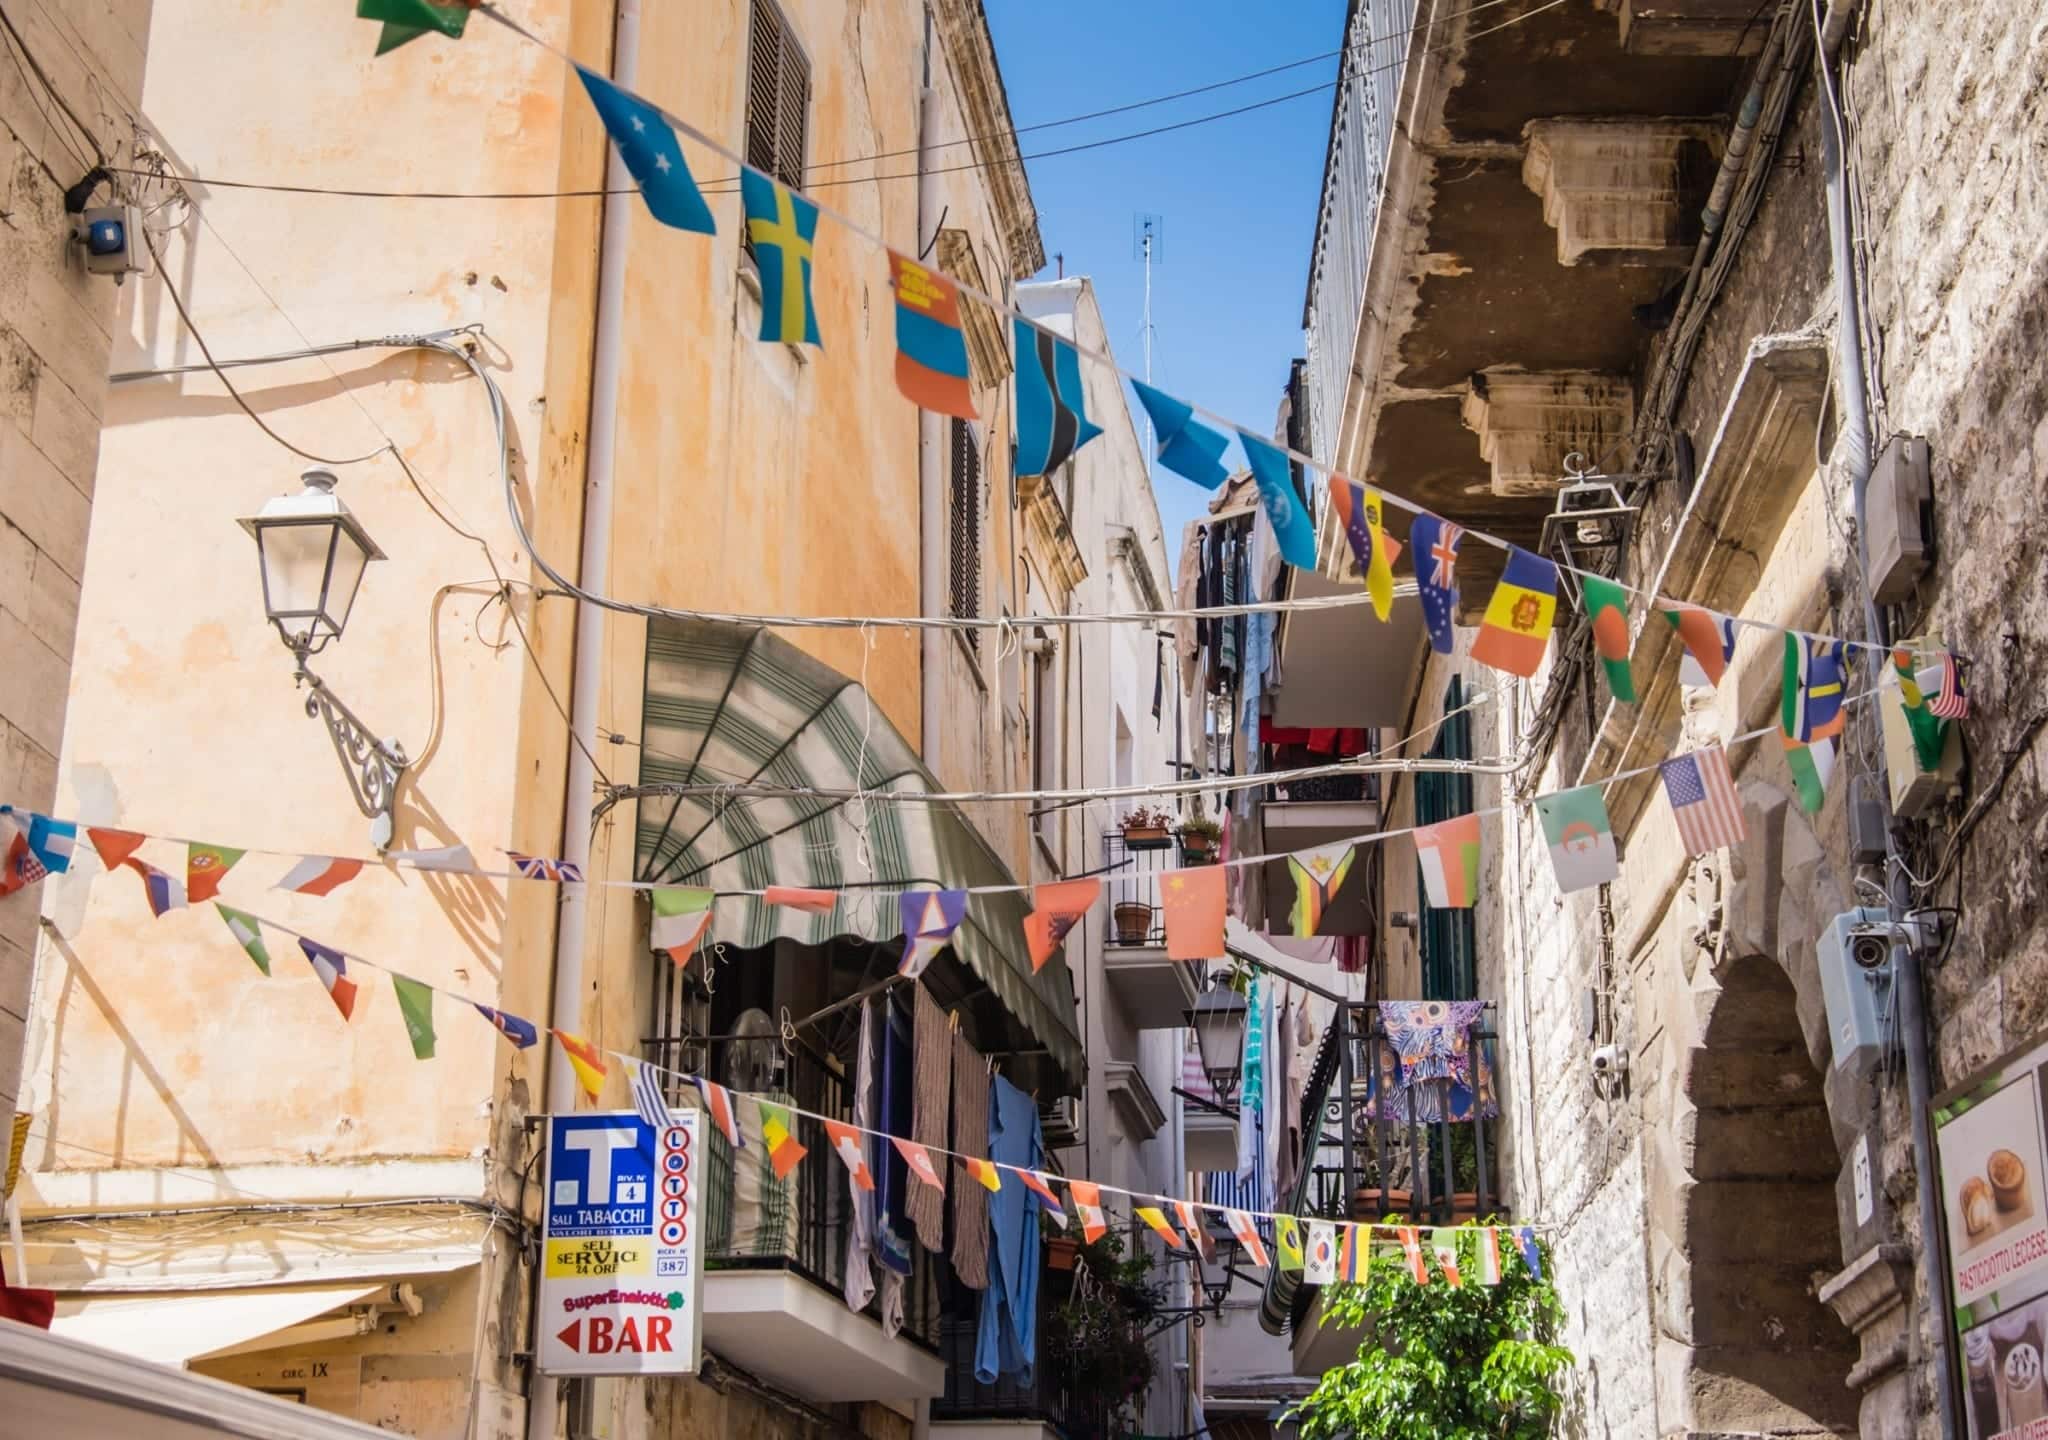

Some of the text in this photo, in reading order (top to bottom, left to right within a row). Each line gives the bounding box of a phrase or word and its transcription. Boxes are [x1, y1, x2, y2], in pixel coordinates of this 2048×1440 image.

[565, 1128, 637, 1204] T
[625, 1185, 636, 1200] 4
[552, 1208, 646, 1226] SALI TABACCHI
[551, 1228, 645, 1237] VALORI BOLLATI
[557, 1250, 639, 1264] SERVICE
[576, 1263, 618, 1275] 24 ORE
[660, 1261, 685, 1271] 387
[563, 1289, 670, 1313] SuperEnalotto
[588, 1315, 673, 1354] BAR
[312, 1363, 328, 1377] IX
